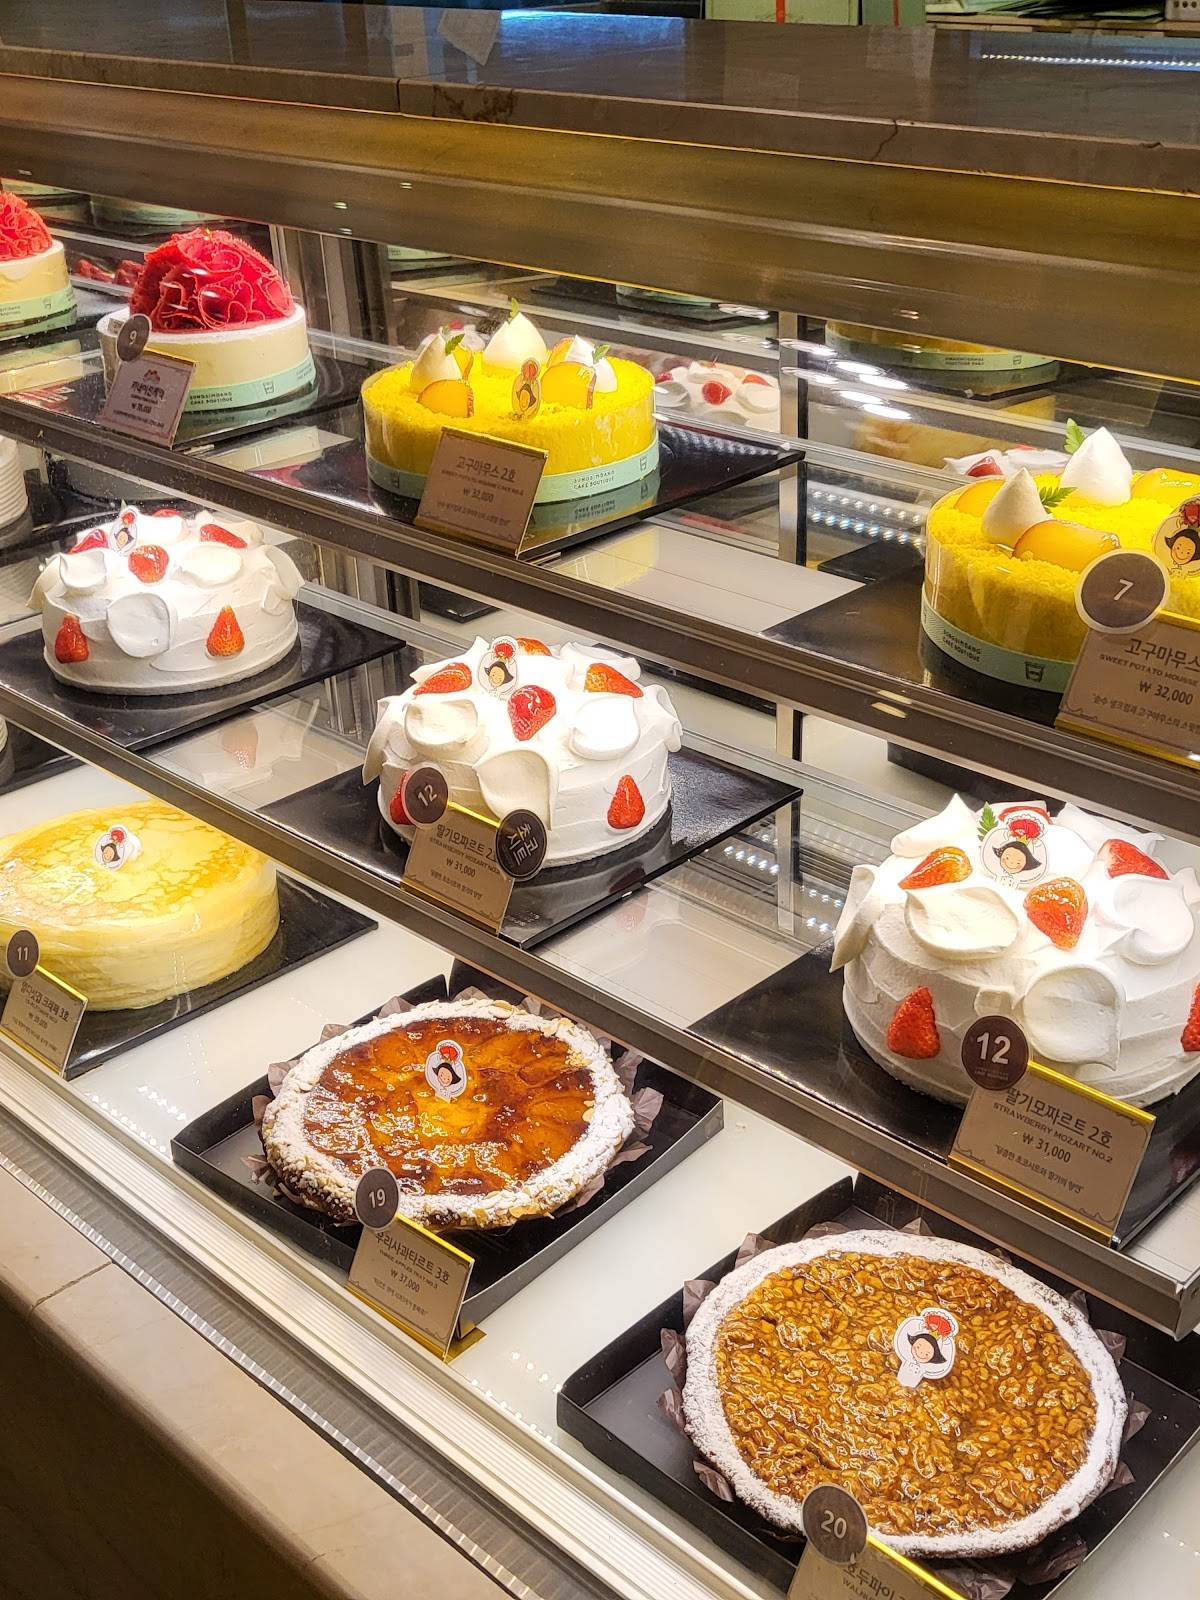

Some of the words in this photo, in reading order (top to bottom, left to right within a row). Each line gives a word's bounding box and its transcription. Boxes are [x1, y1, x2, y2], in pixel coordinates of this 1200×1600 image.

[129, 330, 137, 345] 9
[455, 456, 499, 478] 고구마무스
[1113, 578, 1134, 601] 7
[1124, 638, 1200, 673] 고구마무스
[1100, 653, 1129, 667] SWEET
[1129, 660, 1163, 677] POTATO
[1164, 671, 1199, 688] MOUSSE
[1154, 684, 1194, 706] 32,000
[418, 784, 438, 807] 12
[454, 861, 476, 878] 31,000
[17, 946, 29, 961] 11
[976, 1031, 1011, 1065] 12
[1005, 1087, 1087, 1136] 딸기모짜르트
[1088, 1126, 1113, 1149] 2호
[993, 1102, 1053, 1134] STRAWBERRY
[1053, 1130, 1092, 1153] MOZART
[1091, 1148, 1113, 1163] NO.2
[1035, 1138, 1071, 1163] 31,000
[368, 1188, 386, 1209] 19
[375, 1231, 434, 1276] 우리사과타르트
[435, 1266, 451, 1286] 3호
[399, 1273, 420, 1293] 37,000
[820, 1509, 847, 1539] 20
